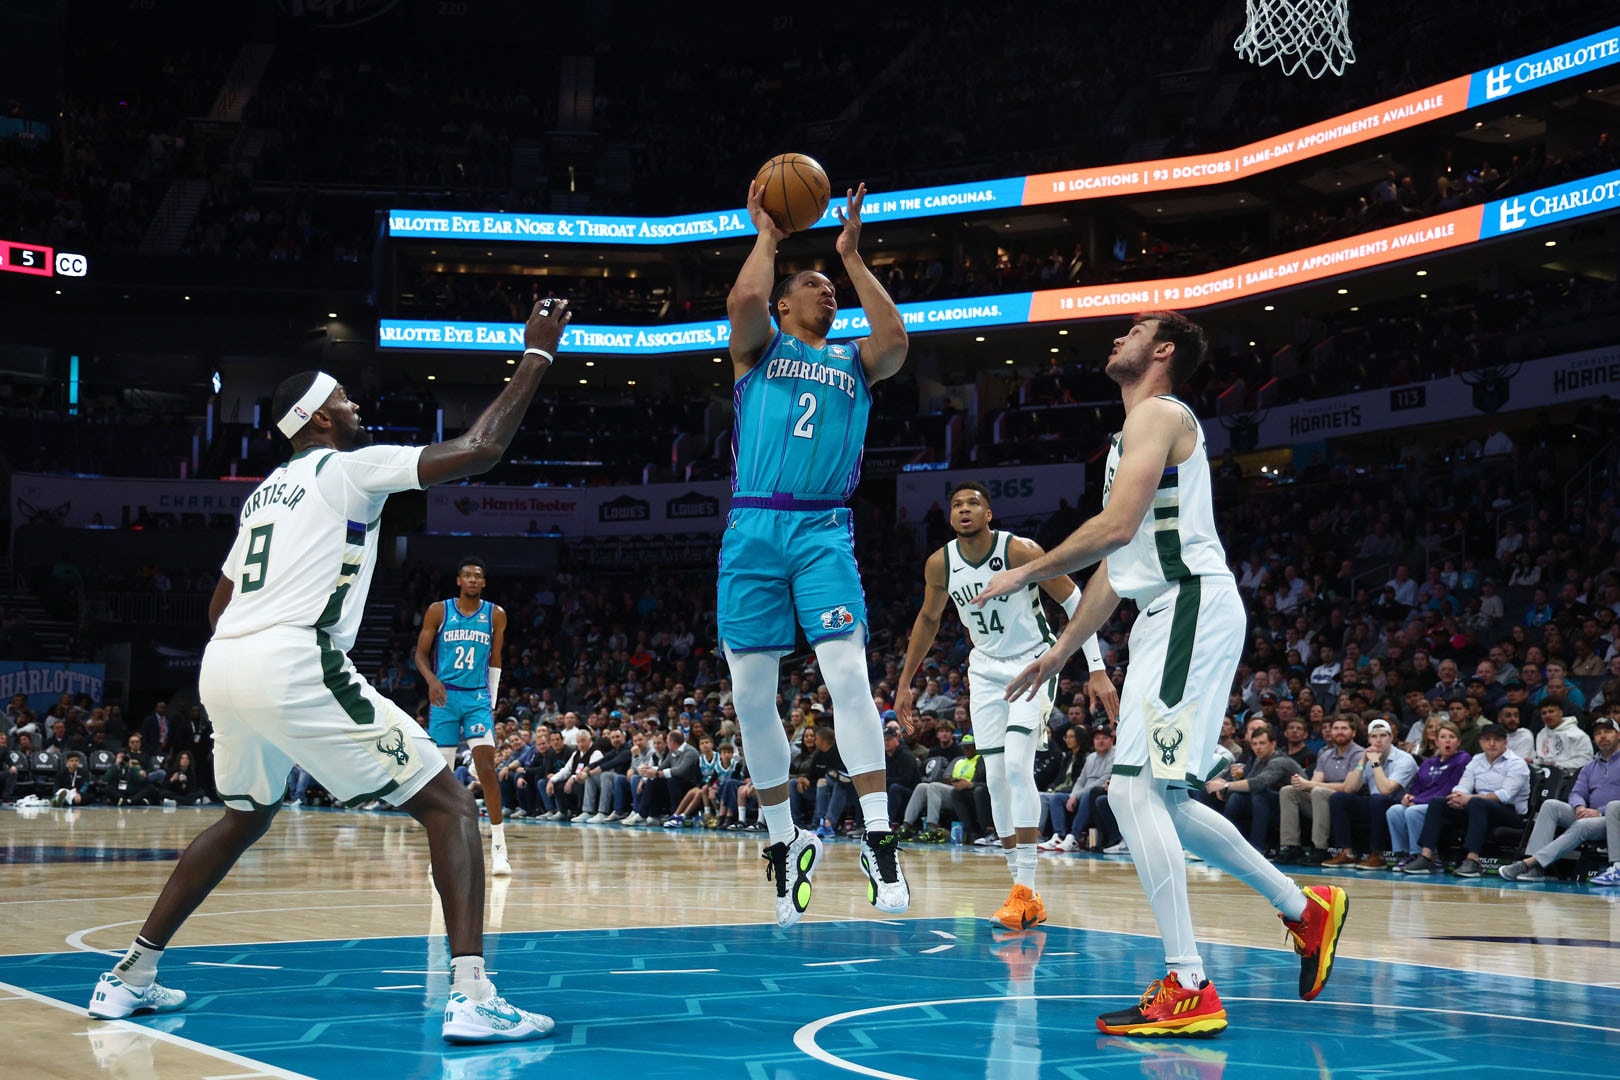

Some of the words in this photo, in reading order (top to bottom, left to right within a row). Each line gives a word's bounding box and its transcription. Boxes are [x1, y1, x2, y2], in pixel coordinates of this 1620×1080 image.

[1515, 37, 1620, 83] CHARLOTTE
[1053, 181, 1065, 192] 18
[1069, 173, 1139, 191] LOCATIONS
[1153, 169, 1169, 181] 93
[1173, 161, 1231, 179] DOCTORS
[1242, 141, 1295, 167] SAME-DAY
[1297, 115, 1380, 150] APPOINTMENTS
[1382, 95, 1443, 124] AVAILABLE
[860, 203, 880, 215] ARE
[884, 201, 896, 213] IN
[900, 198, 921, 211] THE
[924, 190, 996, 208] CAROLINAS.
[452, 216, 480, 233] EYE
[483, 217, 512, 234] EAR
[515, 218, 555, 236] NOSE
[557, 220, 574, 236] &
[576, 220, 637, 237] THROAT
[638, 219, 718, 237] ASSOCIATES,
[719, 214, 745, 231] P.A.
[22, 250, 35, 266] 5
[60, 257, 82, 273] CC
[1060, 298, 1074, 309] 18
[1078, 291, 1149, 308] LOCATIONS
[1164, 288, 1180, 300] 93
[1184, 278, 1234, 298] DOCTORS
[1245, 262, 1300, 284] SAME-DAY
[1302, 240, 1388, 271] APPOINTMENTS
[1391, 224, 1455, 249] AVAILABLE
[832, 318, 848, 330] OF
[903, 312, 925, 324] THE
[928, 305, 1002, 322] CAROLINAS.
[444, 326, 473, 343] EYE
[476, 327, 506, 344] EAR
[572, 329, 633, 347] THROAT
[635, 329, 716, 347] ASSOCIATES,
[717, 325, 732, 341] P.
[766, 358, 856, 399] CHARLOTTE
[793, 392, 817, 439] 2
[1290, 405, 1361, 436] HORNETS
[282, 485, 306, 511] JR
[482, 497, 527, 511] Harris
[528, 498, 576, 512] Teeter
[241, 523, 275, 594] 9
[971, 610, 1004, 635] 34
[444, 629, 490, 645] CHARLOTTE
[454, 645, 475, 670] 24
